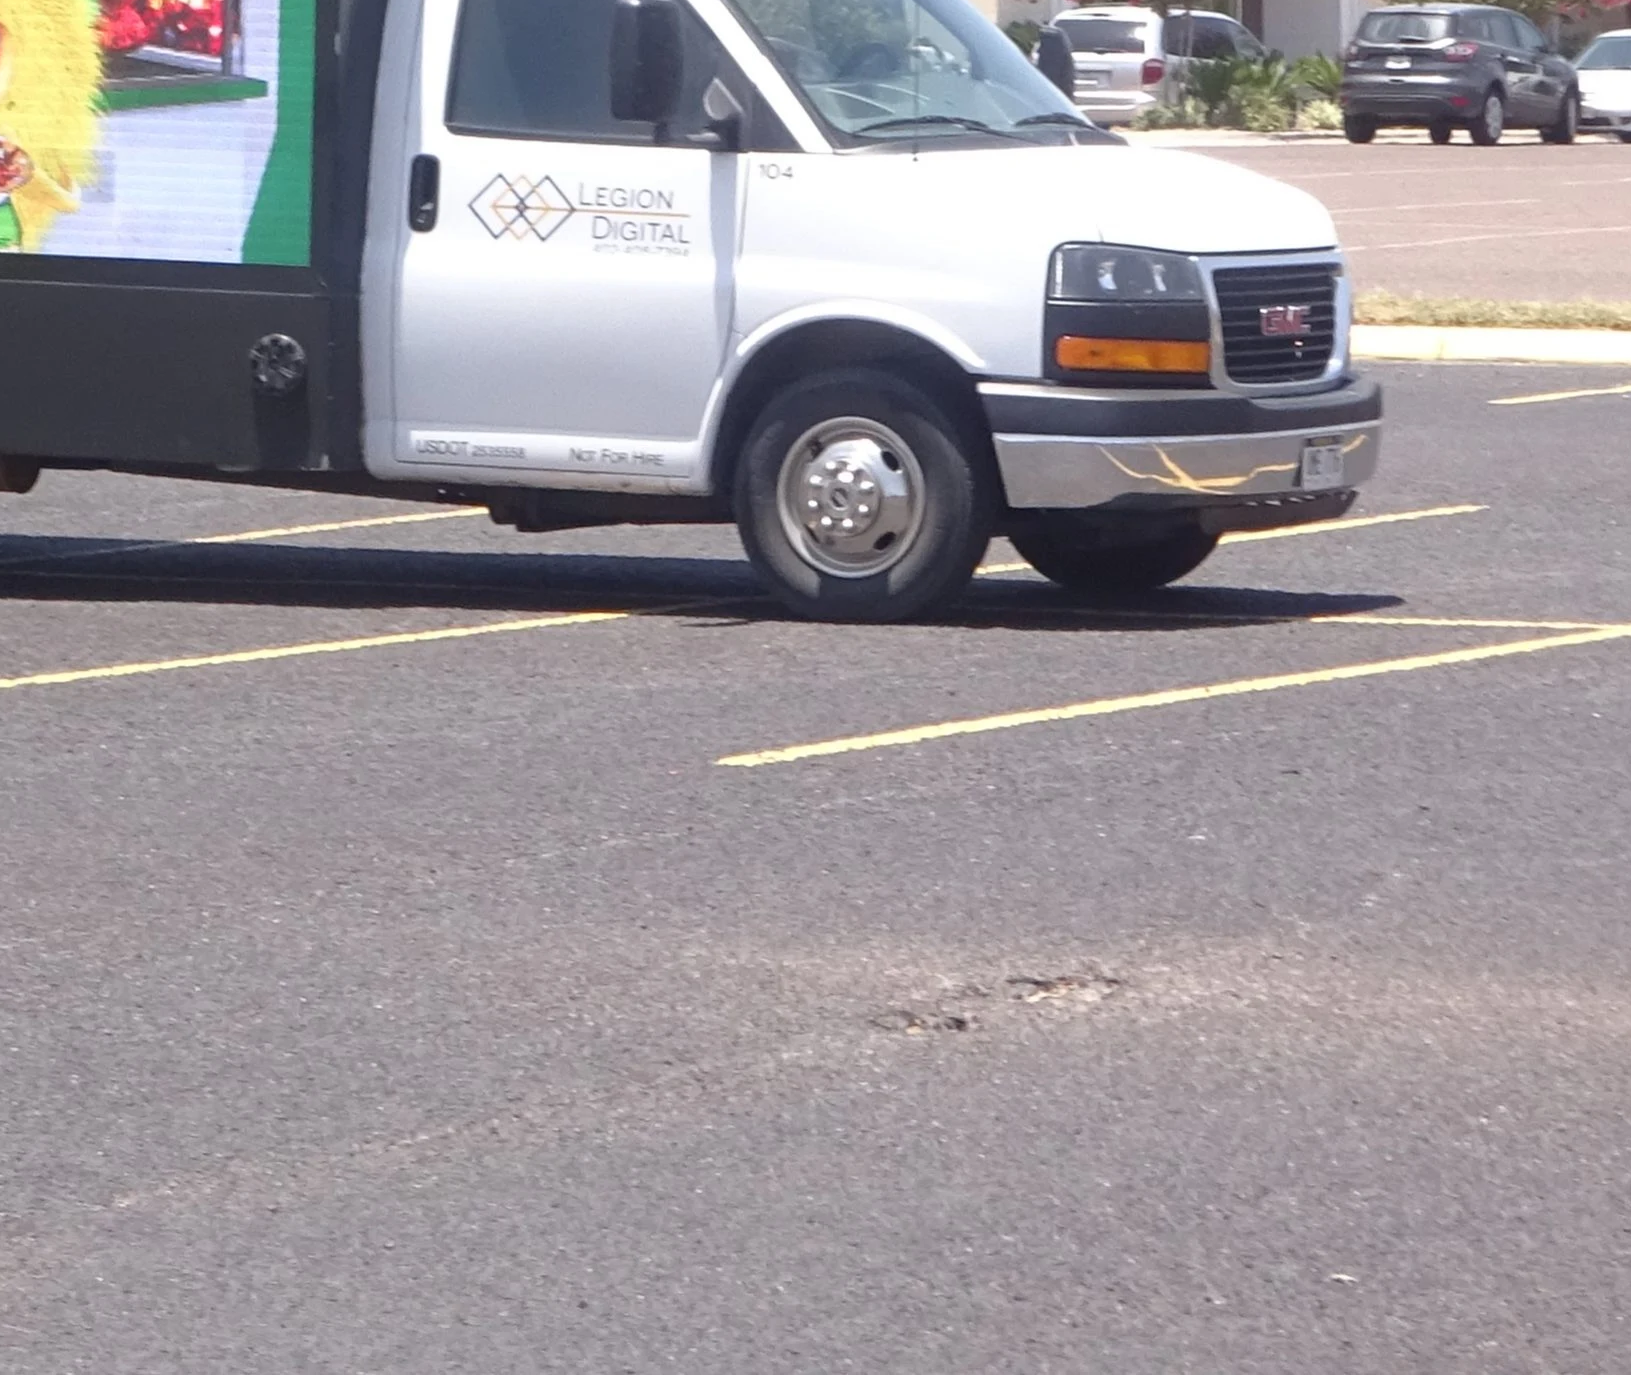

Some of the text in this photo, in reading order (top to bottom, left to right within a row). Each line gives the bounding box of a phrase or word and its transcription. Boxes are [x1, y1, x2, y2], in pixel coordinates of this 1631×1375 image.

[758, 163, 794, 180] 104
[578, 182, 675, 209] LEGION
[591, 216, 691, 244] DIGITAL
